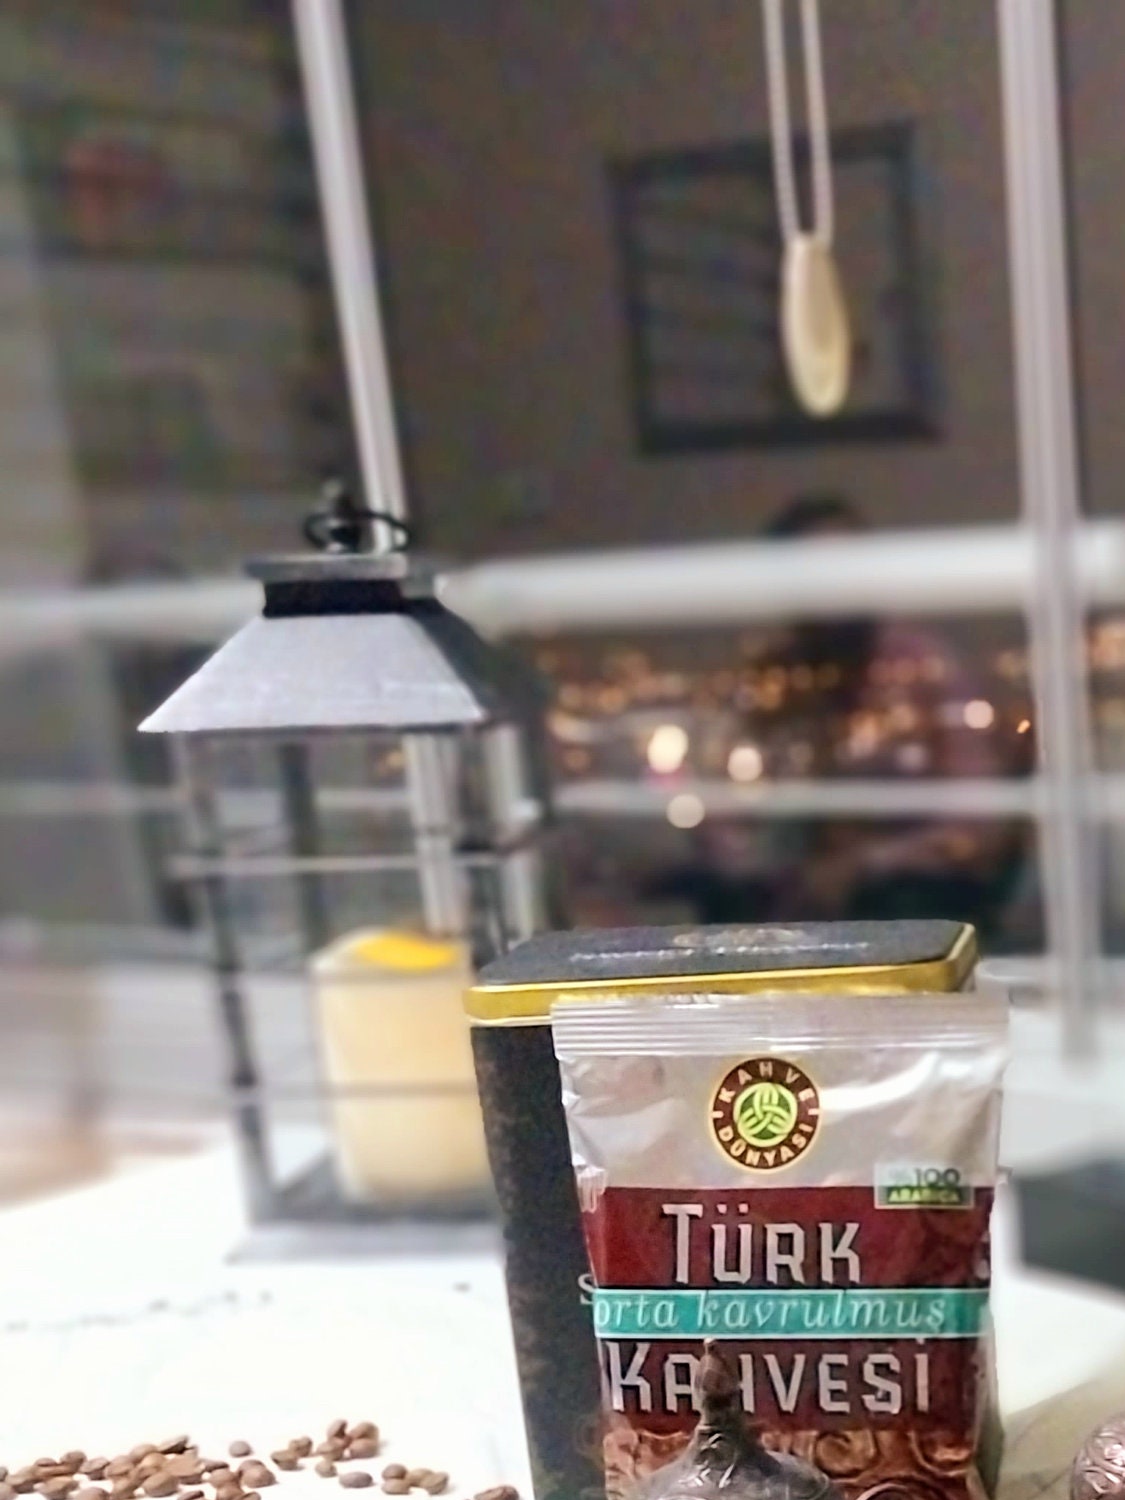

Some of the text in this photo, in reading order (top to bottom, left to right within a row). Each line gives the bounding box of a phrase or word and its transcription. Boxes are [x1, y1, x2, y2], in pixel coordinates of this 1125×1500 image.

[717, 1061, 814, 1104] KAHVE
[662, 1203, 862, 1284] TÜRK
[594, 1290, 946, 1334] orta kavrulmuş
